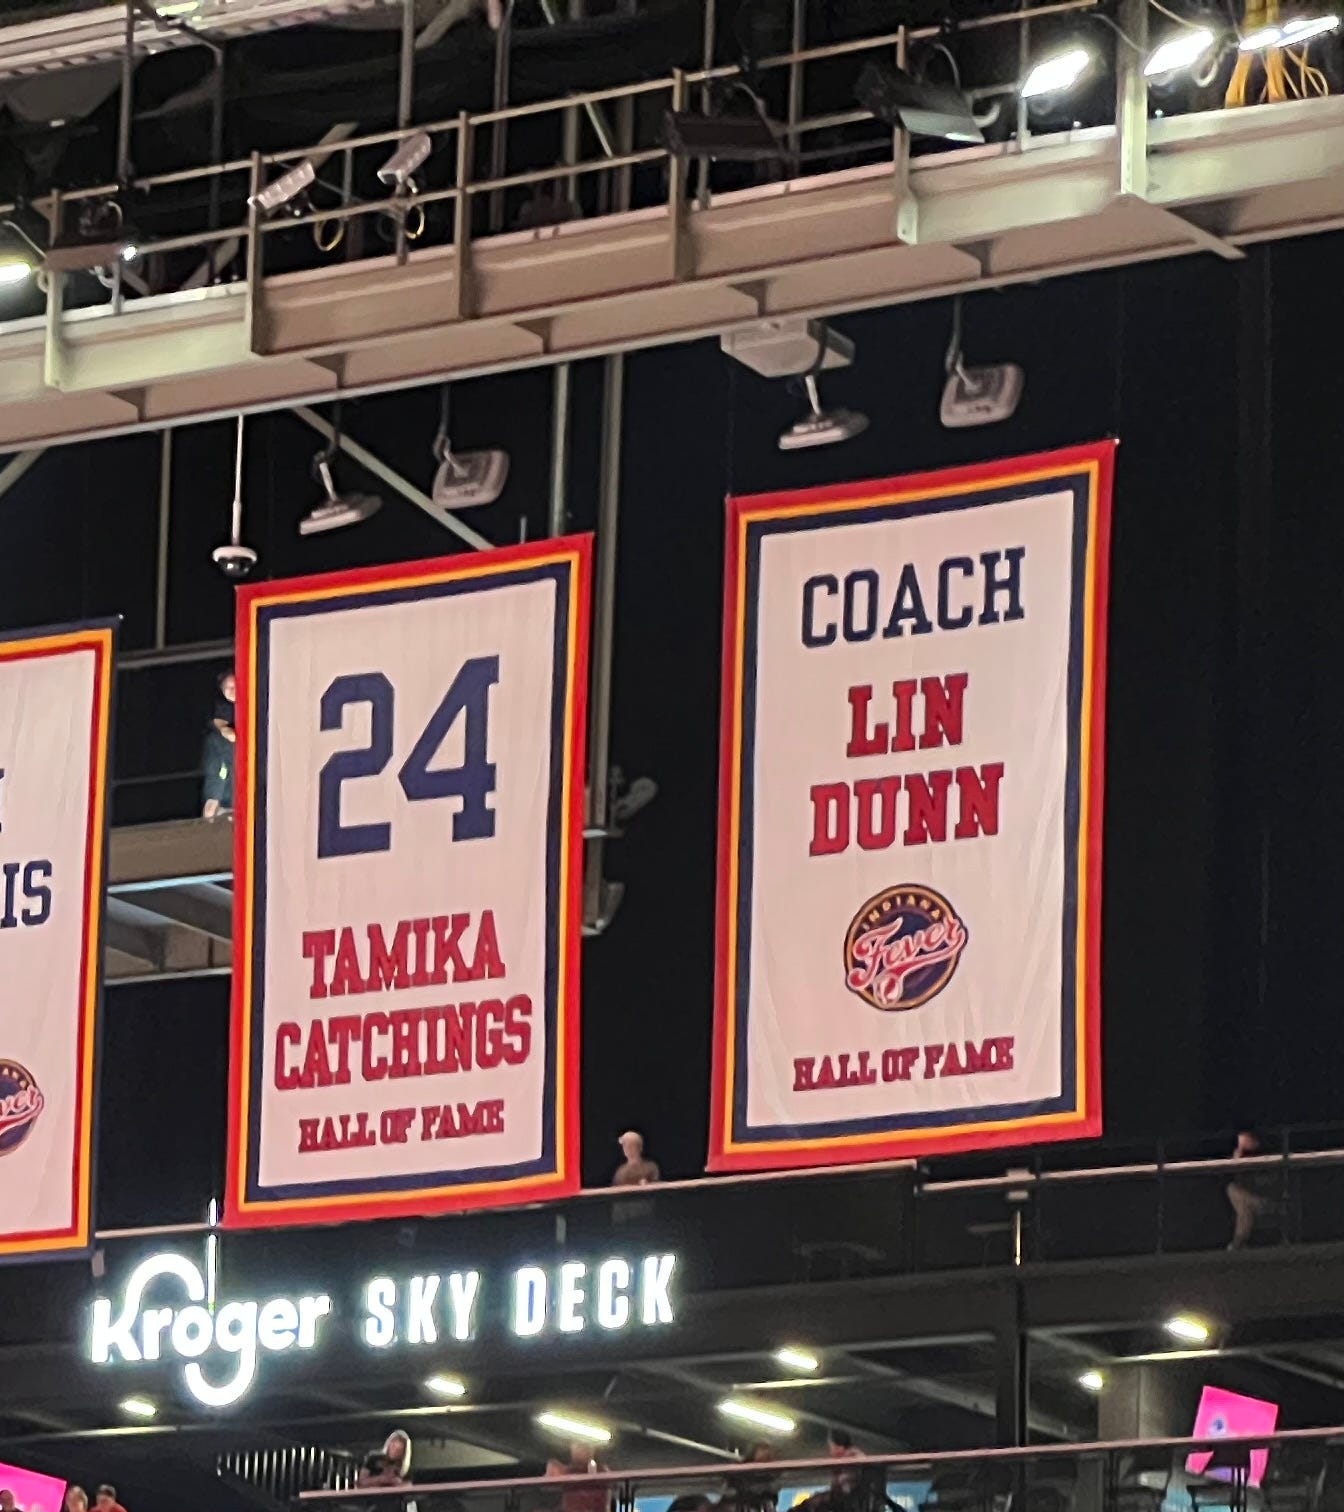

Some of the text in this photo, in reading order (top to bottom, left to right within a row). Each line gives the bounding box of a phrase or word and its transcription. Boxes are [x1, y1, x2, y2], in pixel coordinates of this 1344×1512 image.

[801, 547, 1025, 648] COACH
[317, 654, 500, 860] 24
[846, 673, 968, 757] LIN
[809, 762, 1004, 856] DUNN
[302, 909, 505, 998] TAMIKA
[847, 916, 966, 990] Fever
[274, 994, 531, 1090] CATCHINGS
[793, 1036, 1014, 1092] HALL OF FAME
[298, 1099, 504, 1153] HALL OF FAME
[92, 1253, 676, 1406] Kroger SKY DECK
